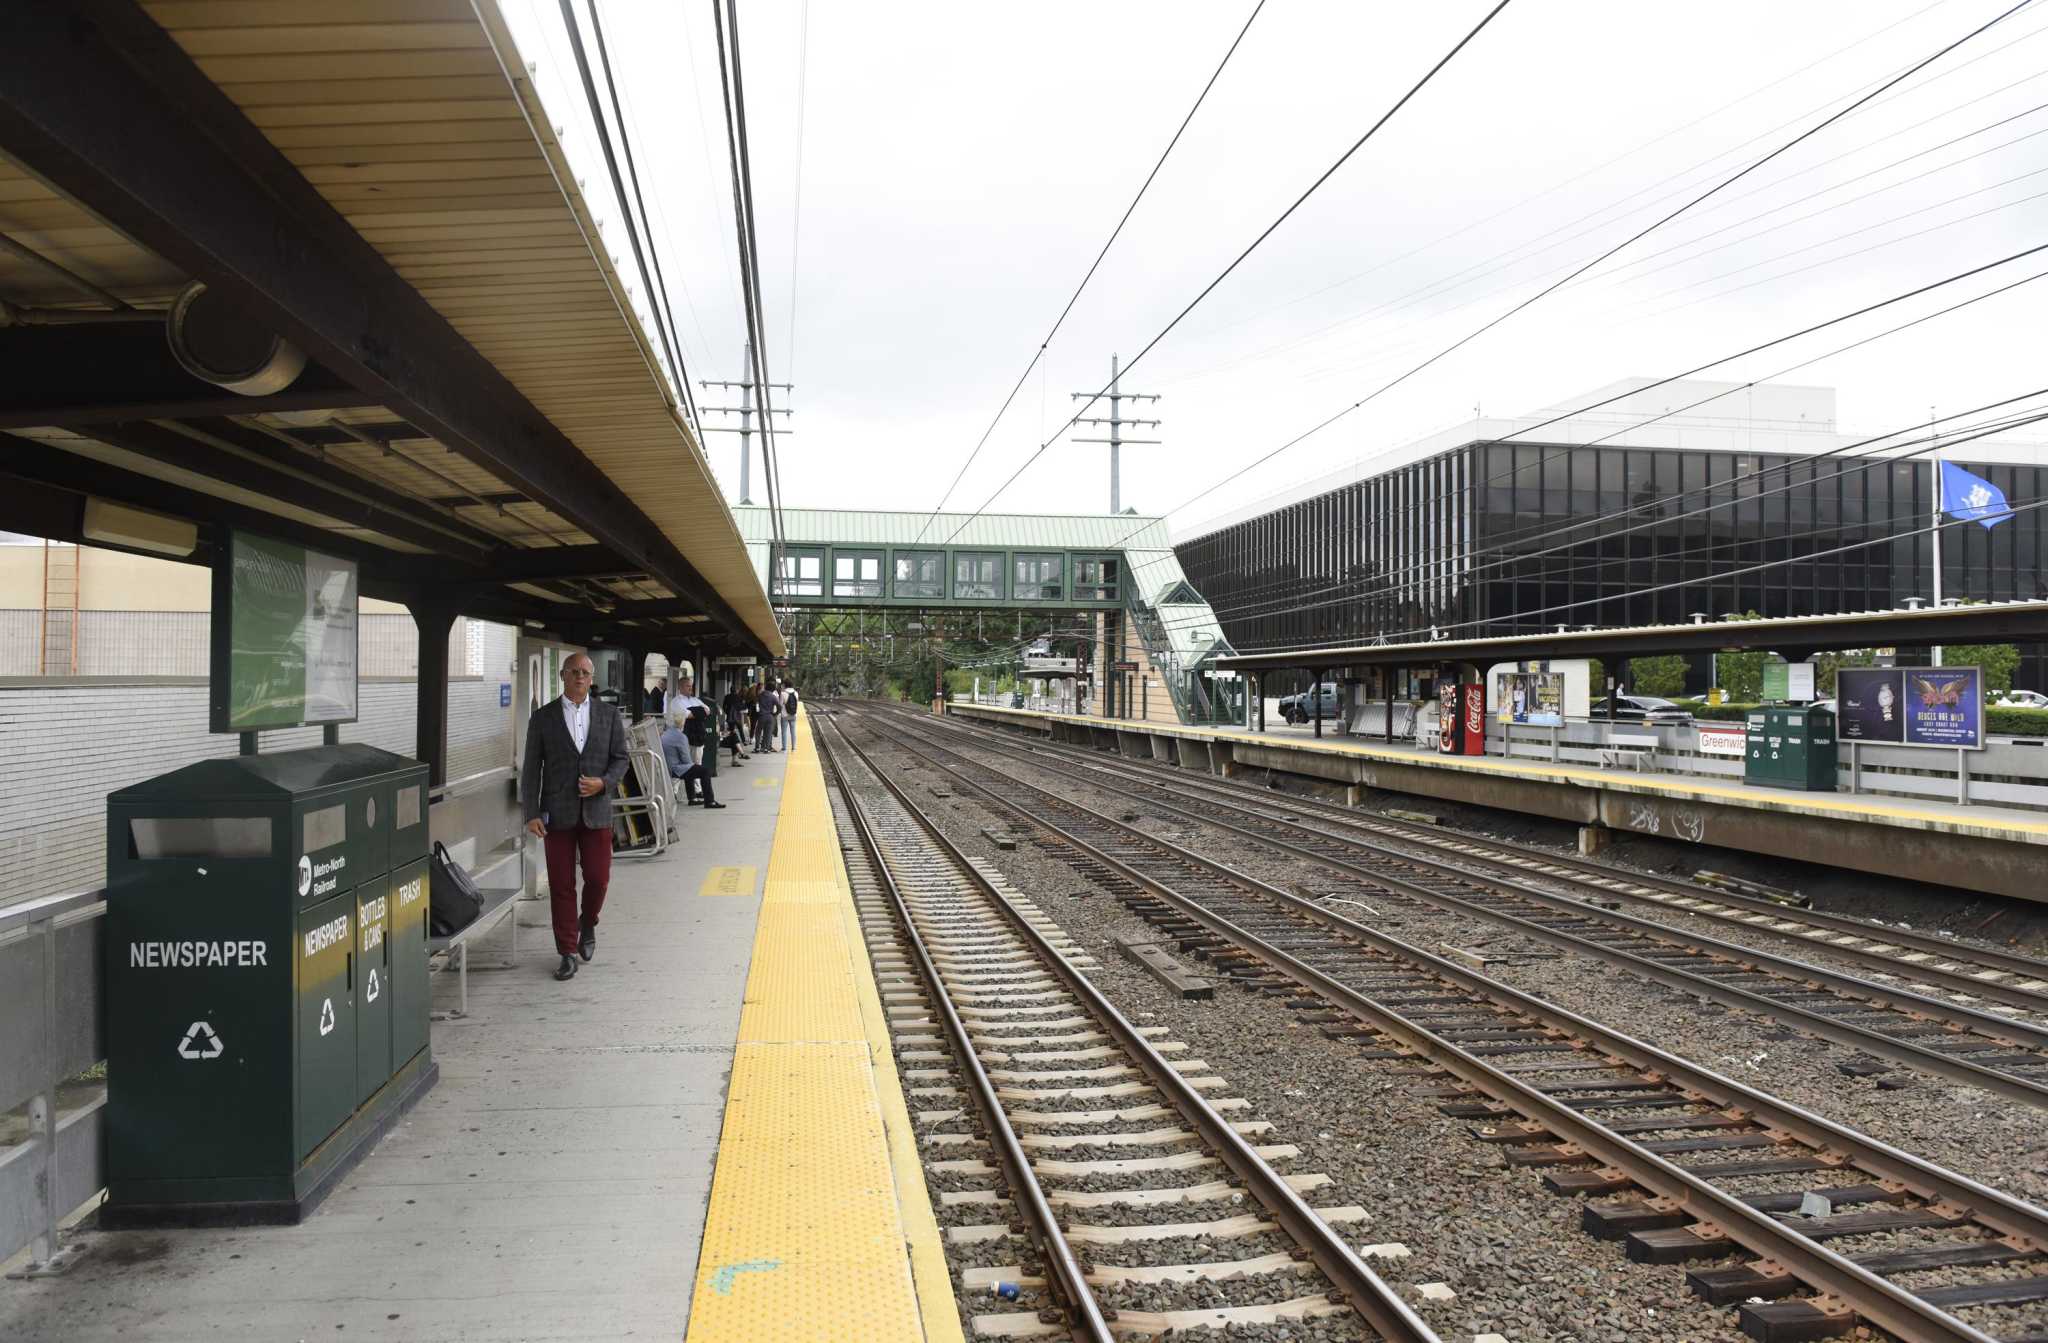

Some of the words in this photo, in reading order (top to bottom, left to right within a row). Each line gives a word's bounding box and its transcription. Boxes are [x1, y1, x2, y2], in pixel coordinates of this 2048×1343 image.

[1701, 734, 1745, 749] Greenwic
[313, 856, 345, 878] Metro-North
[313, 876, 337, 896] Railroad
[399, 879, 421, 906] TRASH
[361, 896, 385, 927] BOTTLES
[305, 915, 348, 957] NEWSPAPER
[364, 931, 369, 952] &
[369, 923, 382, 949] CANS
[130, 941, 267, 967] NEWSPAPER
